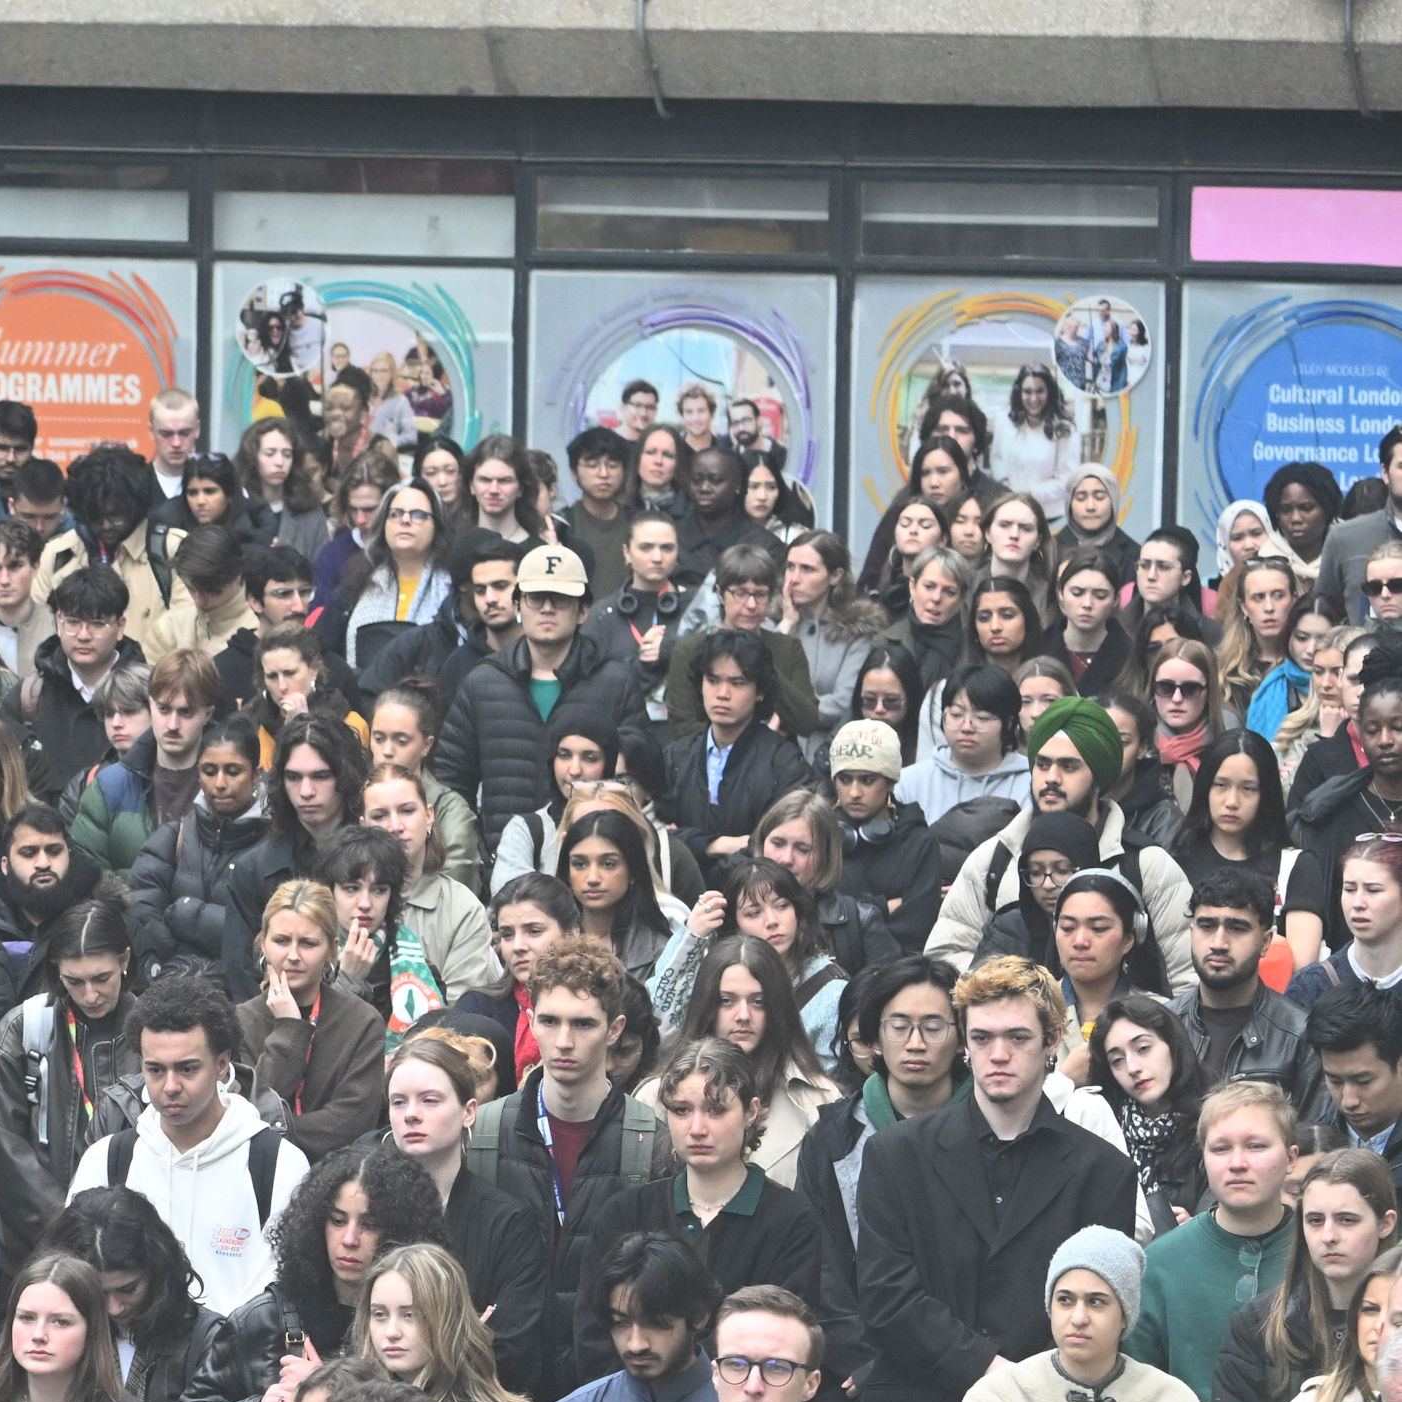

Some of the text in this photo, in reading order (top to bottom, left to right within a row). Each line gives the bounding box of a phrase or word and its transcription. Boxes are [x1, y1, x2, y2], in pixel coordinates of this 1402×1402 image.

[1269, 383, 1402, 405] Cultural Londo
[1266, 412, 1402, 434] Business Lond
[1253, 440, 1358, 463] Governance
[545, 556, 562, 574] F
